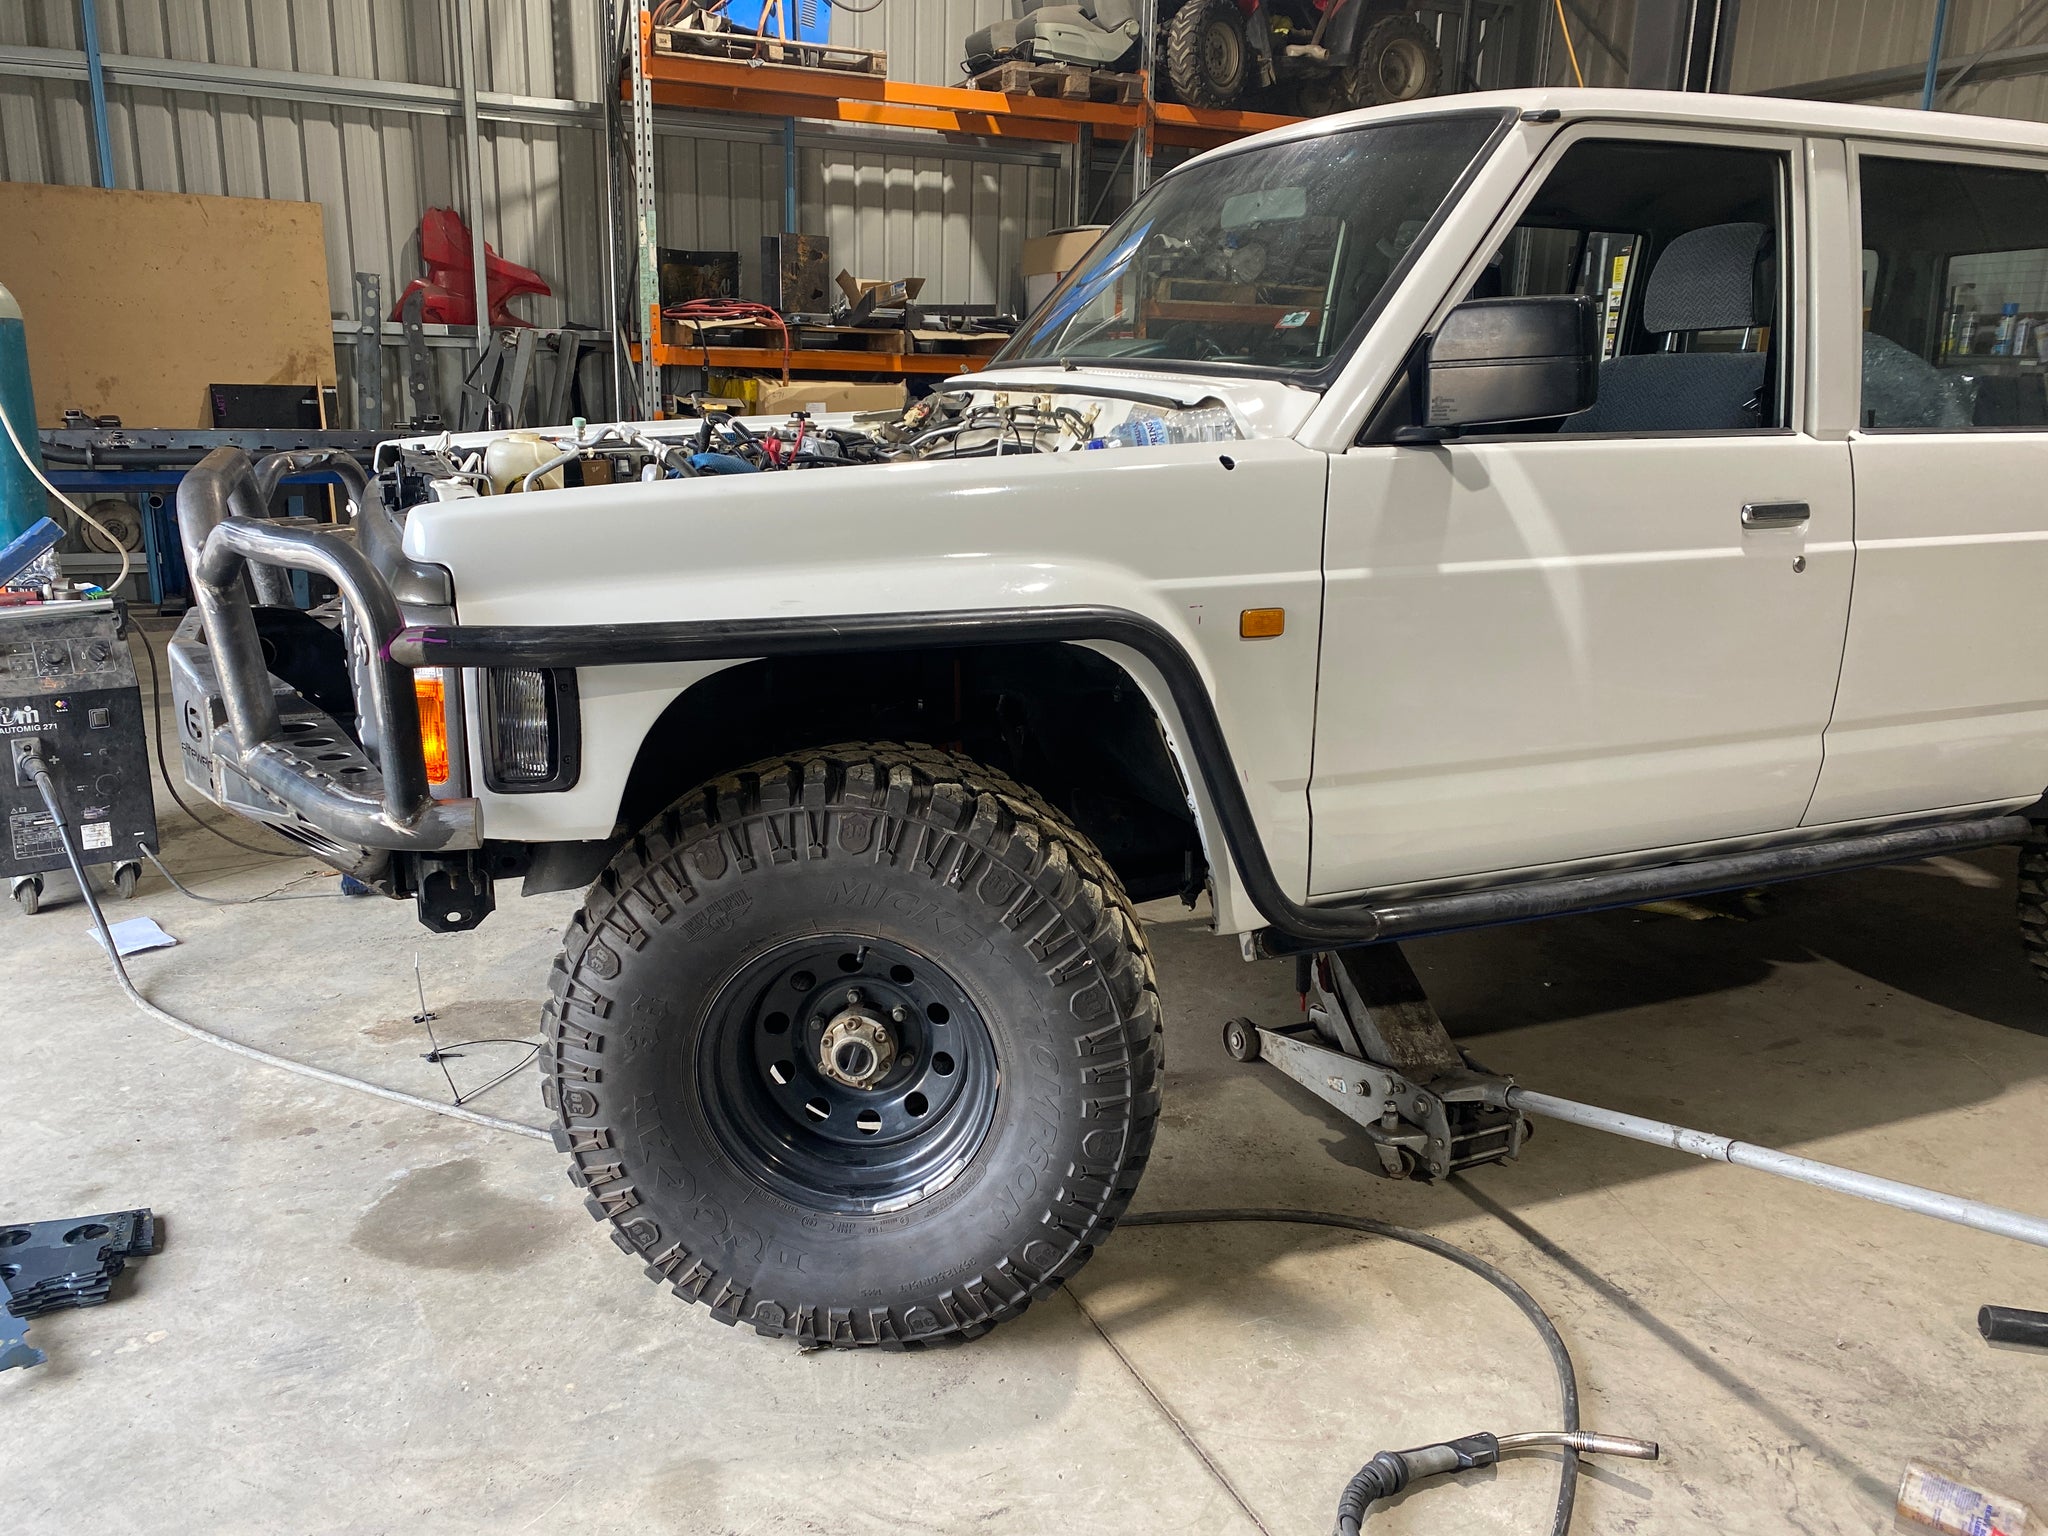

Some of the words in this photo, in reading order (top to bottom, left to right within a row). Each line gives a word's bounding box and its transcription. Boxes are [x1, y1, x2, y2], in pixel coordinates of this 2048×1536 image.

[0, 724, 41, 734] AUTOMIG
[823, 879, 1013, 965] MICKEY
[996, 988, 1062, 1231] THOMPSON
